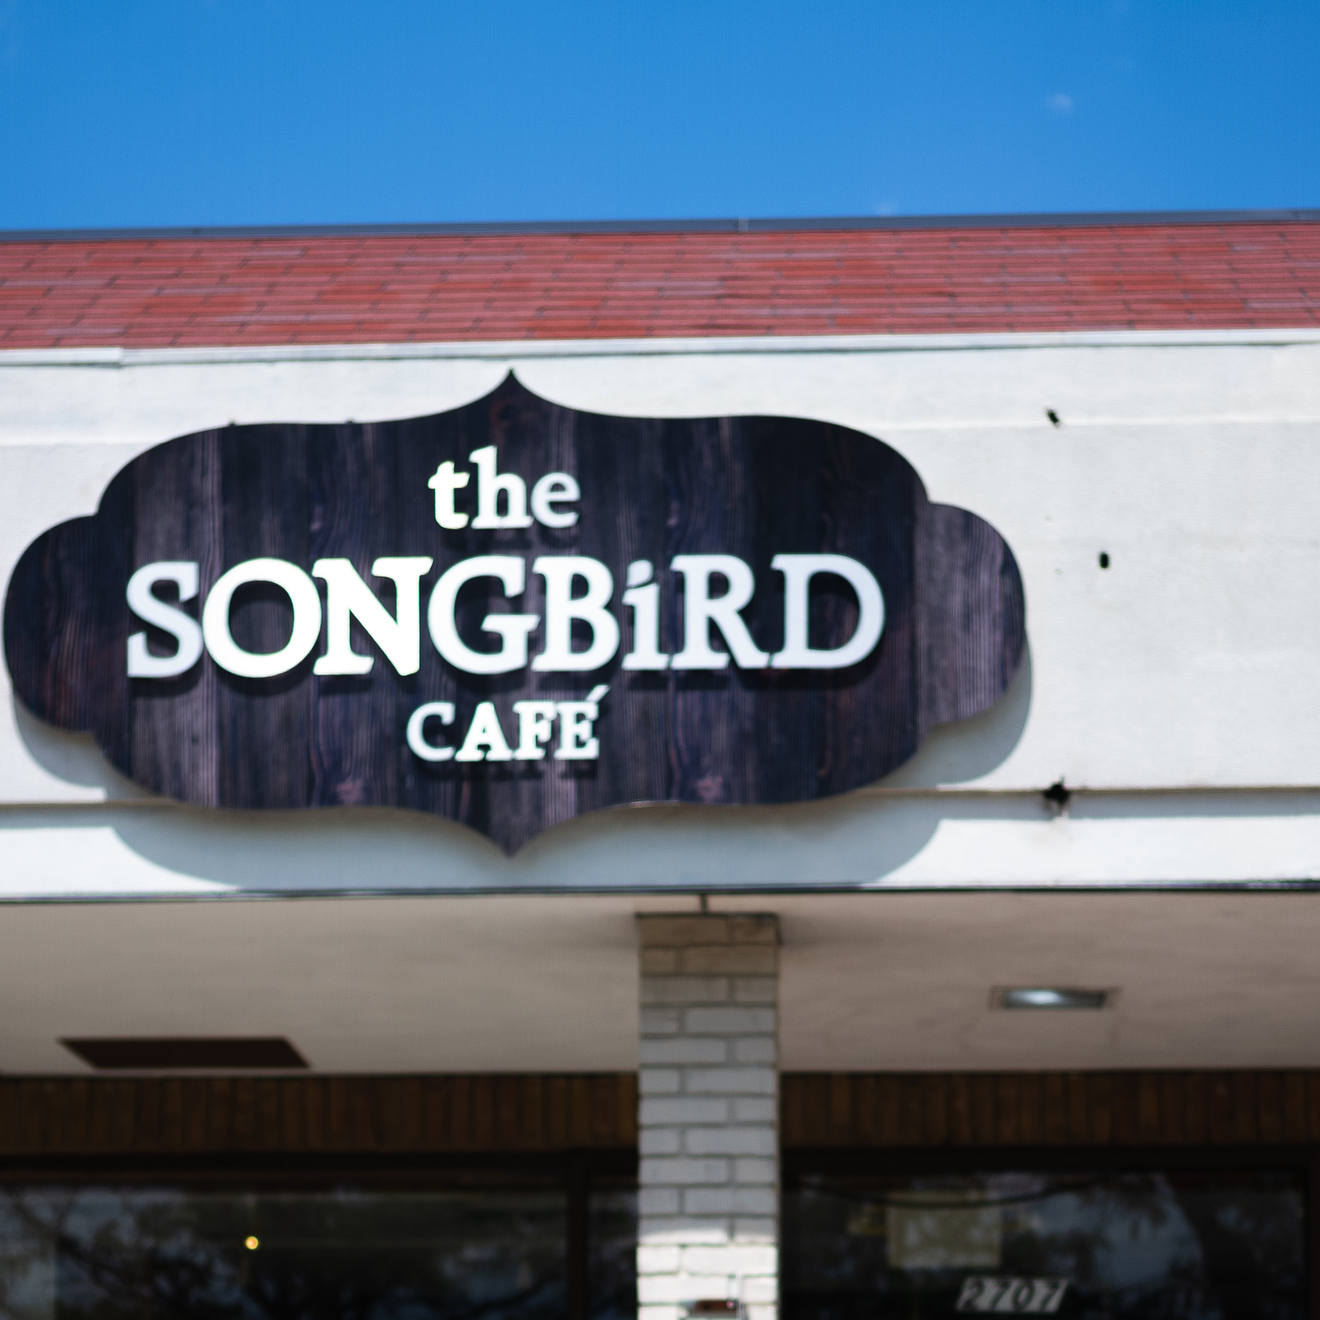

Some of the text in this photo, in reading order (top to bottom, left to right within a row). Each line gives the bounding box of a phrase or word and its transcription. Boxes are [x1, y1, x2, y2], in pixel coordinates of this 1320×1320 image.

[428, 446, 580, 528] the
[406, 686, 611, 762] CAFÉ
[962, 1279, 1061, 1311] 2707
